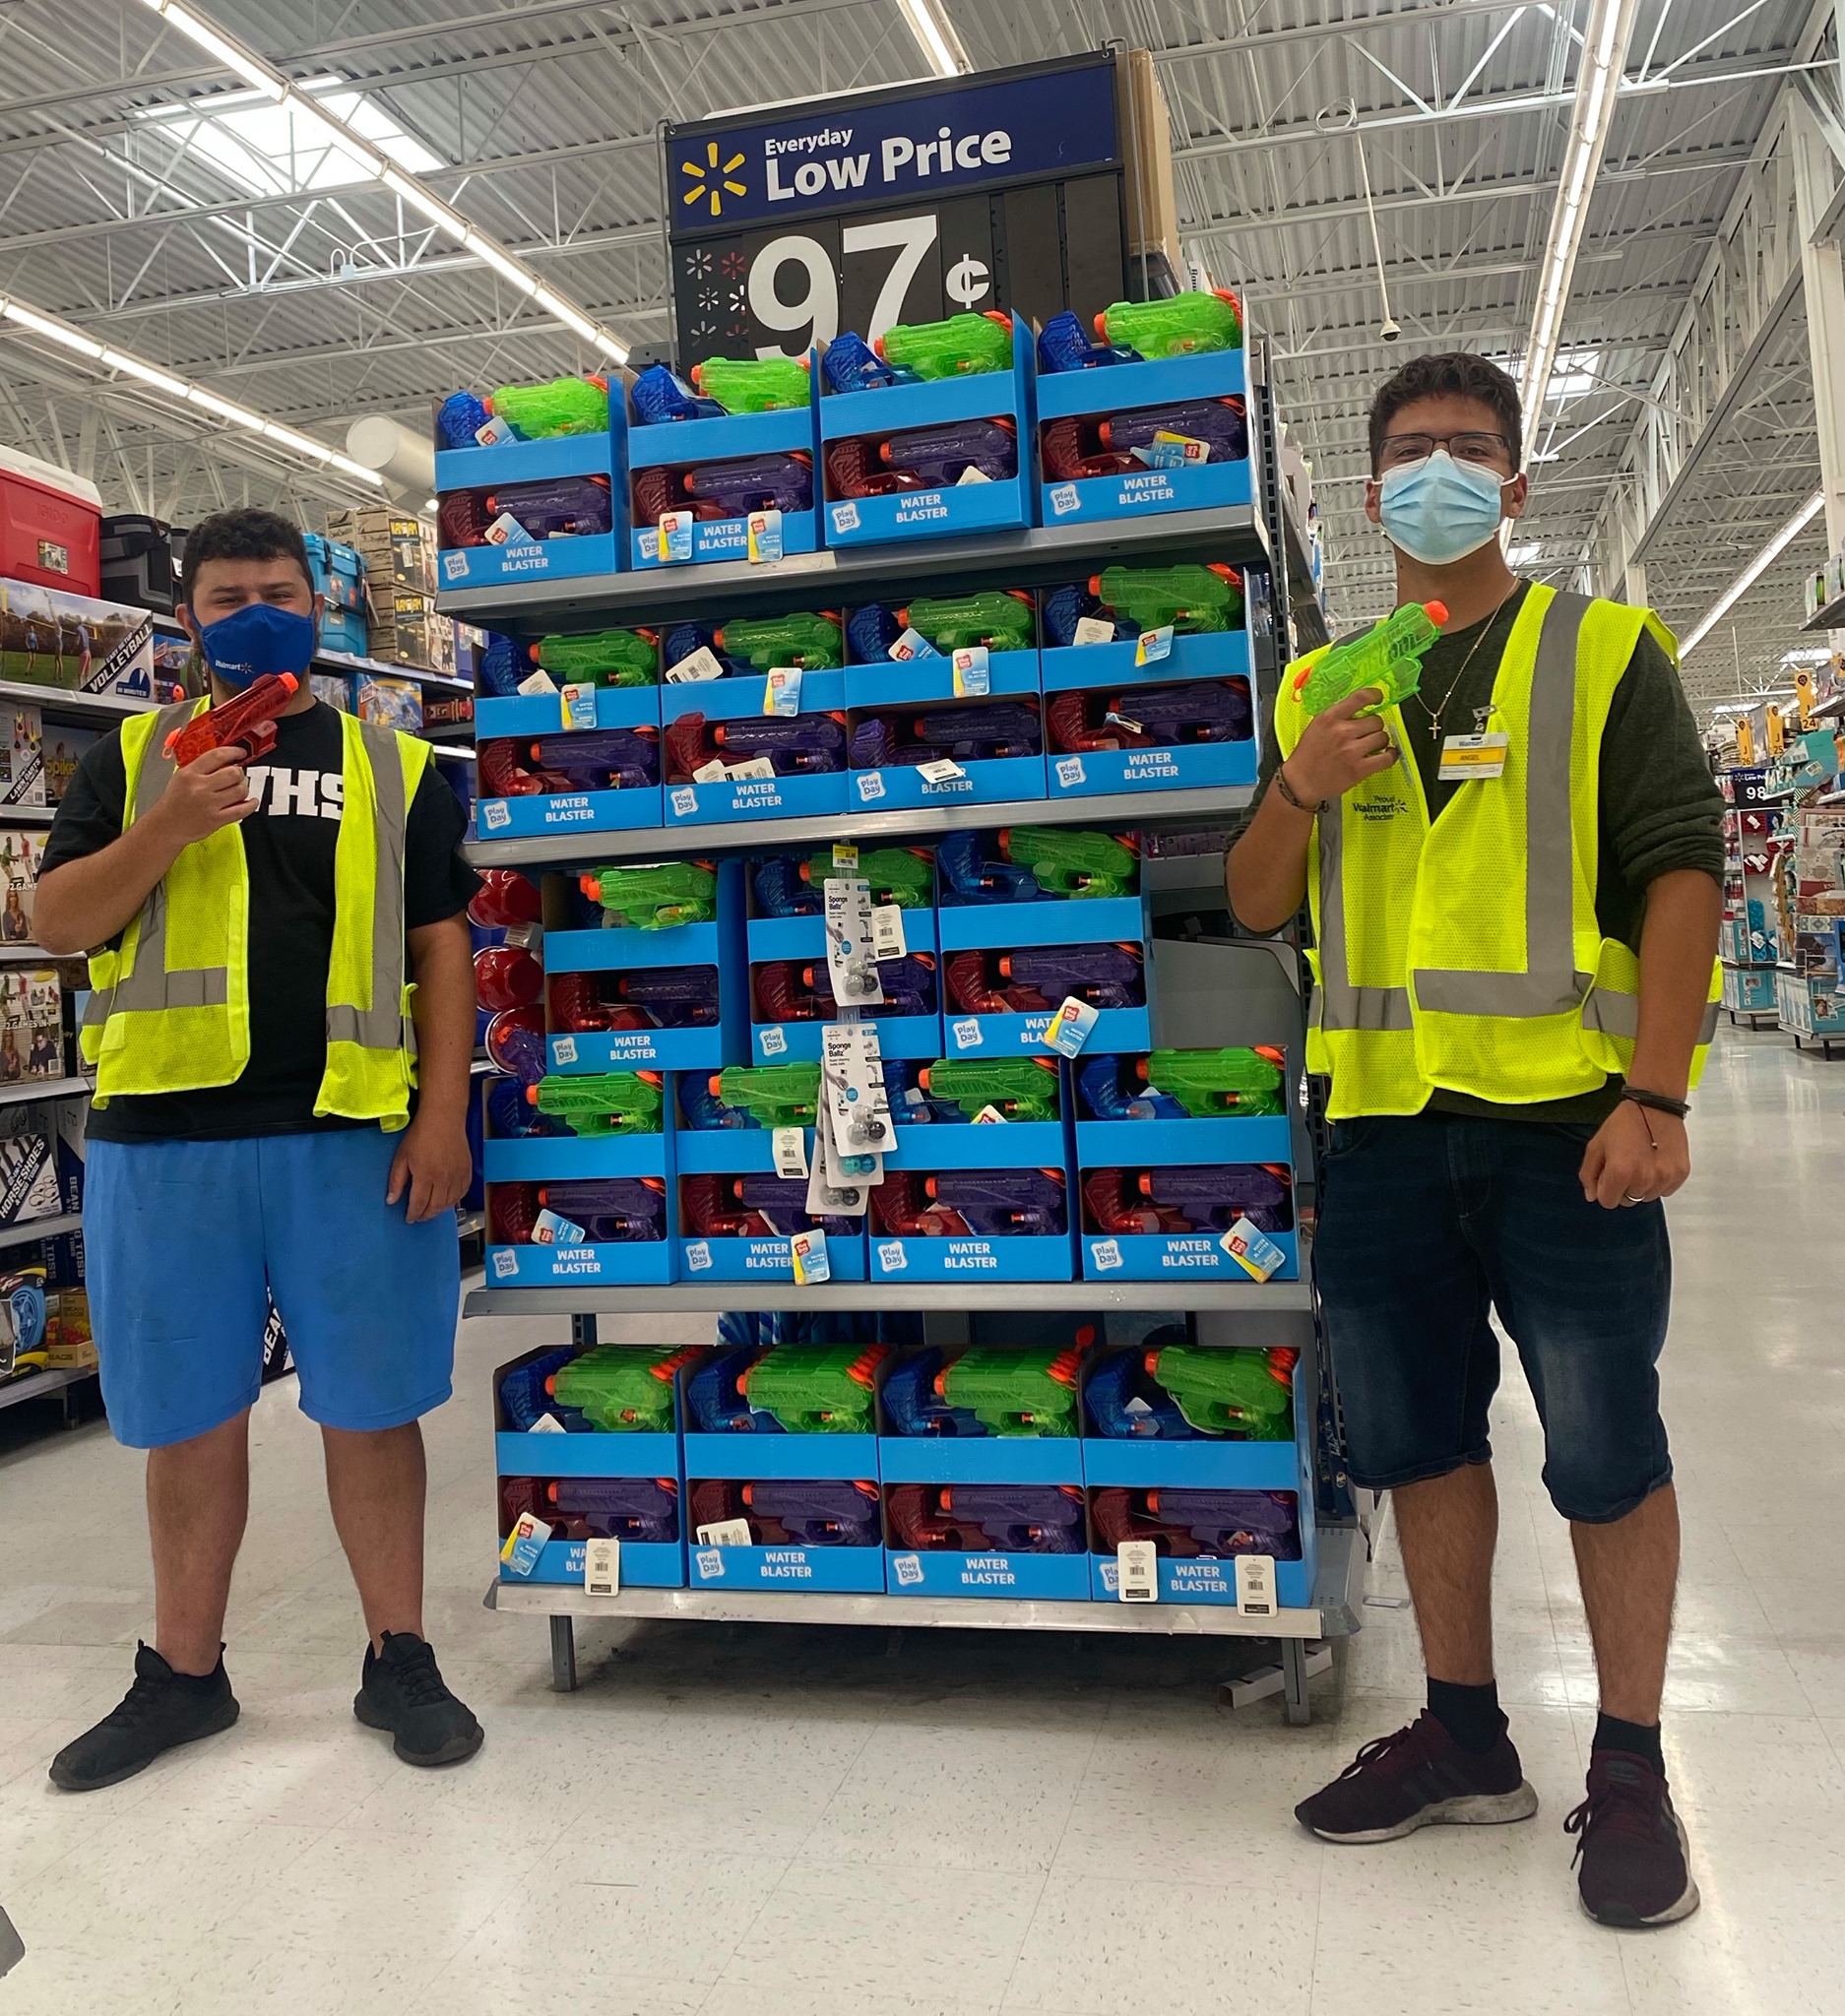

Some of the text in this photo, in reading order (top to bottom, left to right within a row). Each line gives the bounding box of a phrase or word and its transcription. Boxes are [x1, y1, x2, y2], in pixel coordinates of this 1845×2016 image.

[765, 128, 854, 157] Everyday
[766, 127, 1012, 201] Low Price
[1123, 475, 1168, 490] WATER
[900, 494, 941, 508] WATER
[1118, 488, 1175, 505] BLASTER
[896, 506, 948, 523] BLASTER
[704, 524, 741, 536] WATER
[699, 536, 747, 550] BLASTER
[506, 546, 542, 558] WATER
[501, 558, 548, 572] BLASTER
[90, 623, 153, 693] VOLLEYBALL
[215, 660, 241, 671] Walmart
[1803, 720, 1815, 728] 24
[1128, 752, 1172, 766] WATER
[45, 756, 79, 777] Spike
[1123, 765, 1178, 780] BLASTER
[735, 783, 775, 796] WATER
[922, 781, 973, 794] BLASTER
[1747, 787, 1766, 799] 98
[549, 796, 589, 810] WATER
[732, 795, 782, 809] BLASTER
[1353, 803, 1394, 812] Walmart
[545, 808, 595, 822] BLASTER
[828, 895, 848, 904] Sponge
[1025, 1018, 1052, 1030] WAT
[614, 1036, 651, 1047] WATER
[609, 1048, 657, 1060] BLASTER
[0, 1139, 45, 1219] HORSESHOES
[69, 1176, 79, 1211] BEAN
[750, 1242, 789, 1254] WATER
[949, 1242, 990, 1255] WATER
[1167, 1239, 1211, 1253] WATER
[76, 1242, 86, 1278] TOSS
[557, 1249, 595, 1260] WATER
[1162, 1253, 1219, 1267] BLASTER
[552, 1262, 601, 1274] BLASTER
[745, 1255, 794, 1268] BLASTER
[944, 1255, 997, 1269] BLASTER
[765, 1552, 805, 1564] WATER
[966, 1558, 1008, 1571] WATER
[760, 1565, 812, 1578] BLASTER
[1176, 1565, 1220, 1577] WATER
[961, 1572, 1015, 1585] BLASTER
[1171, 1580, 1228, 1593] BLASTER
